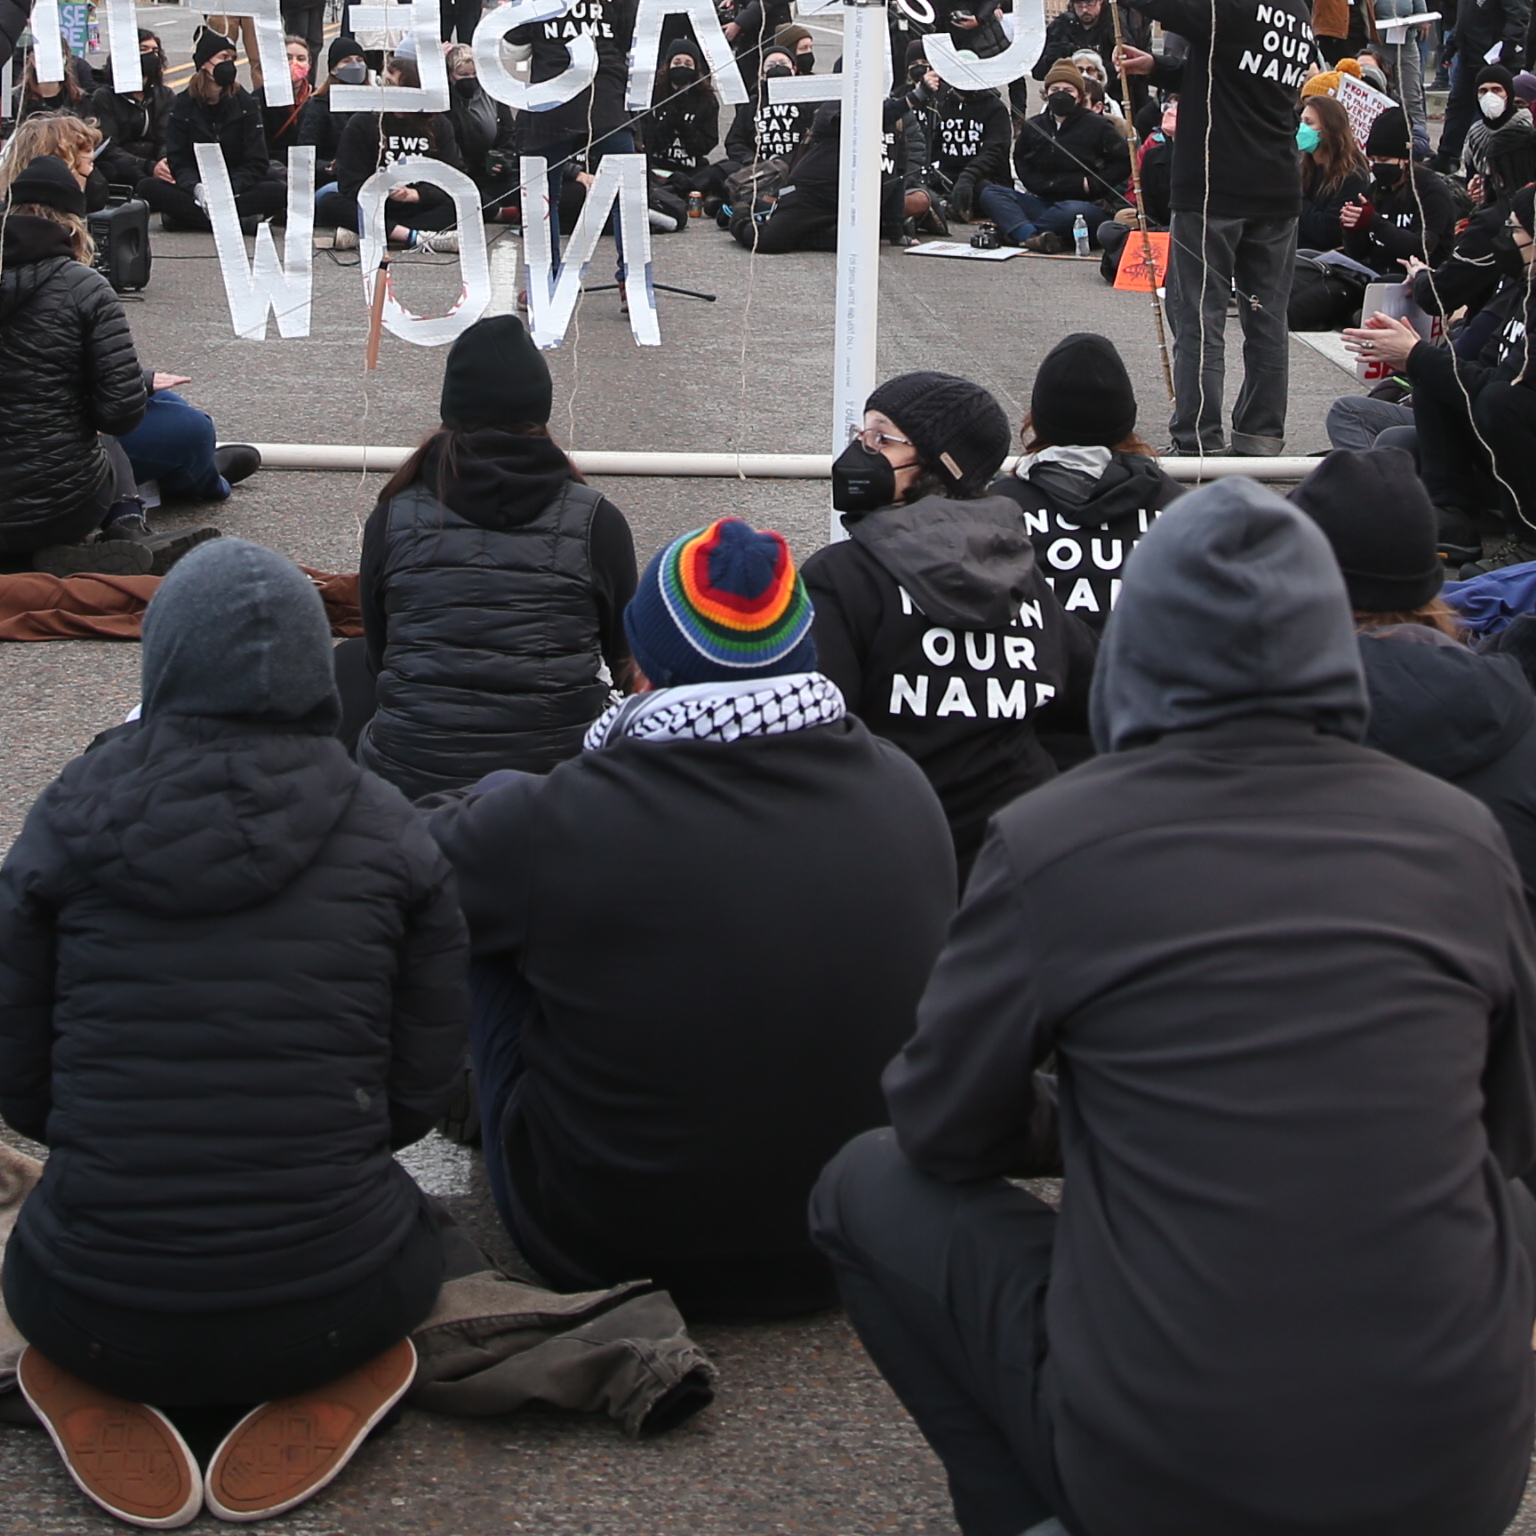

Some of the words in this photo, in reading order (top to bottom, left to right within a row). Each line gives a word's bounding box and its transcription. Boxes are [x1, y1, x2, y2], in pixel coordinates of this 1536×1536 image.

[1256, 4, 1297, 33] NOT
[543, 21, 615, 39] NAME
[1263, 30, 1311, 64] OUR
[1341, 90, 1353, 101] TO
[1344, 81, 1369, 101] FROM
[753, 104, 800, 123] JEWS
[757, 118, 794, 133] SAY
[969, 119, 984, 134] IN
[379, 136, 430, 151] EWS
[754, 132, 801, 144] CEASE
[942, 130, 980, 143] OUR
[1046, 537, 1141, 572] OU
[921, 626, 1038, 672] OUR
